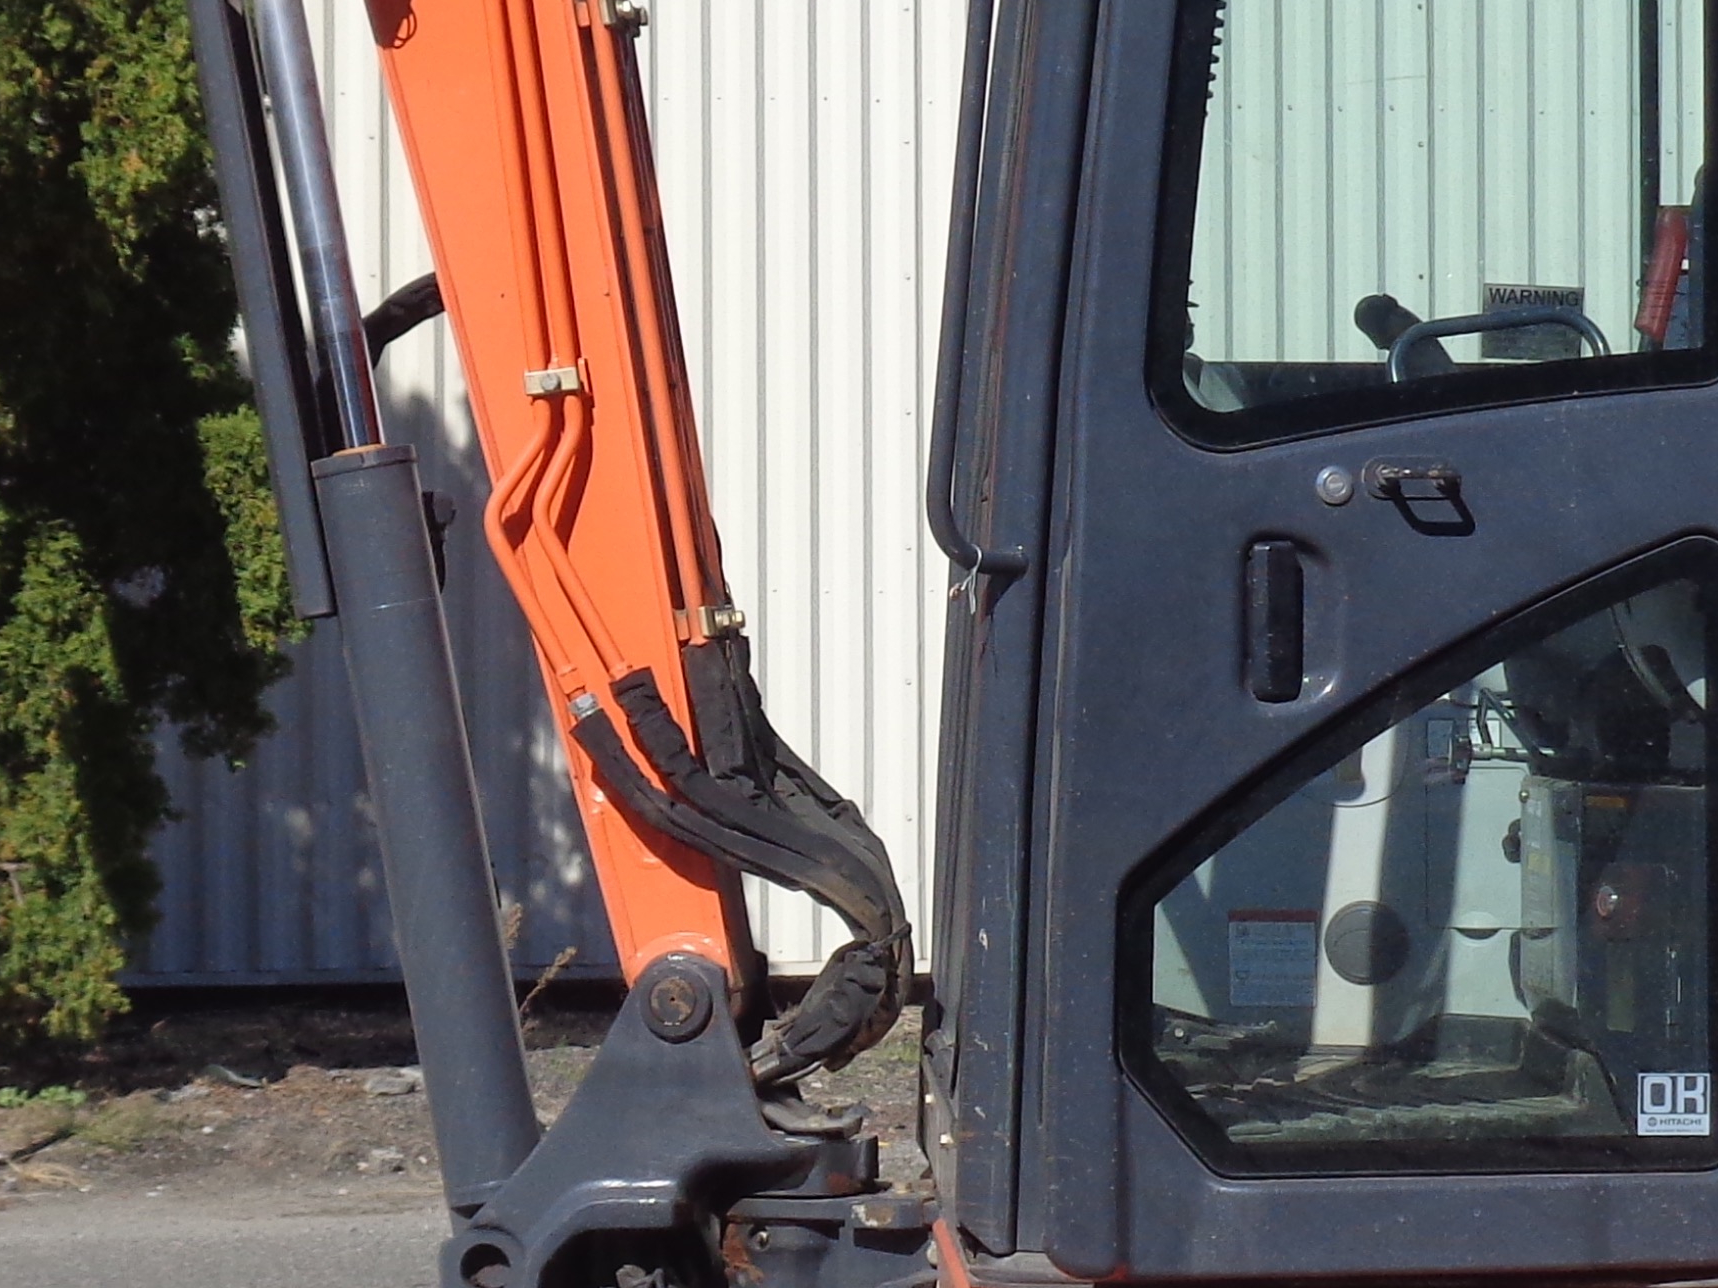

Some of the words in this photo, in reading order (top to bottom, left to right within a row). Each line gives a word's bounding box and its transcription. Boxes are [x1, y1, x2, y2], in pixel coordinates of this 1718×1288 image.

[1488, 287, 1579, 307] WARNING
[1643, 1075, 1705, 1114] OK
[1659, 1117, 1702, 1126] HITACHI
